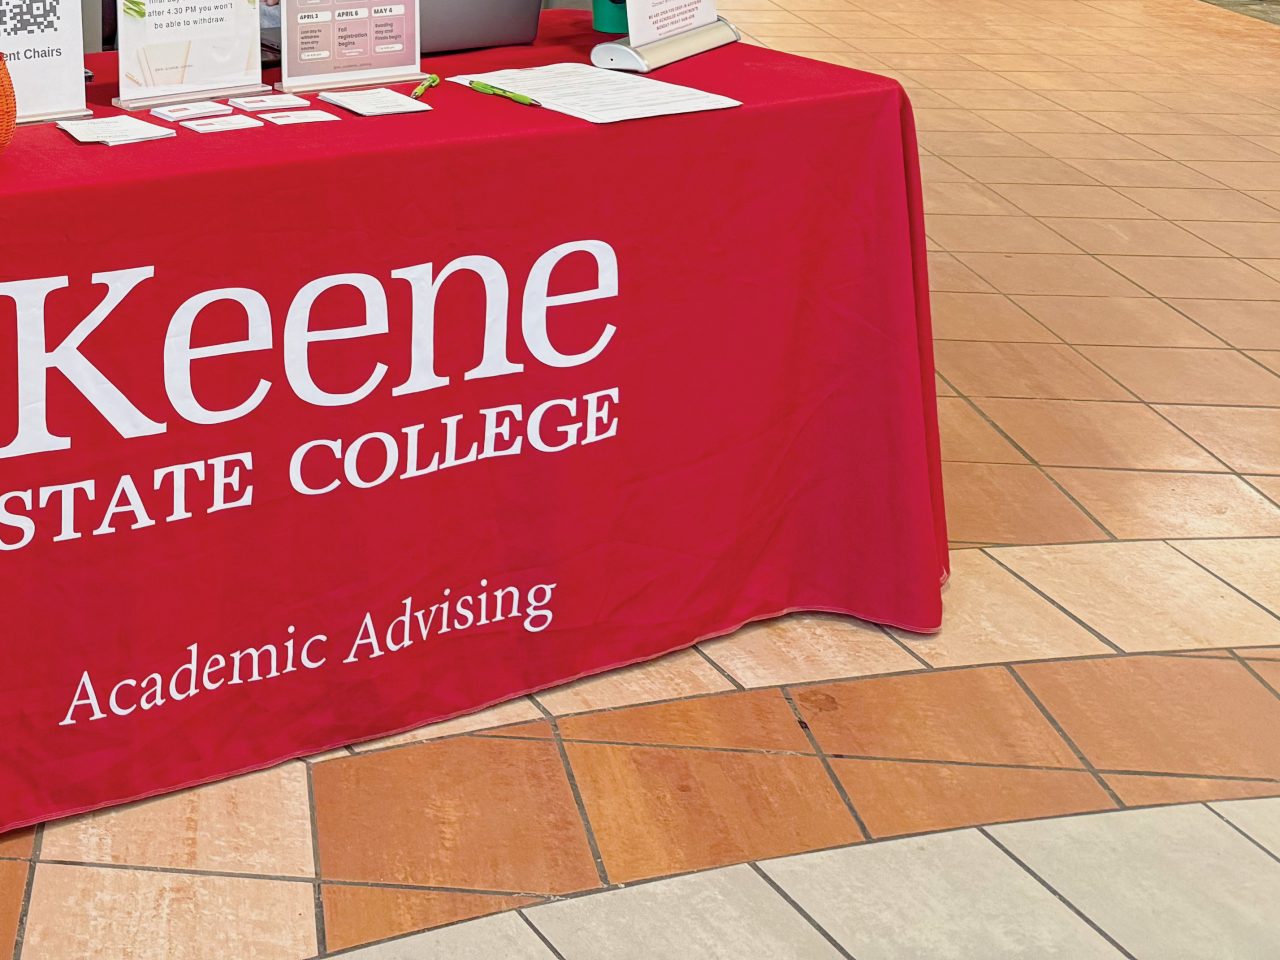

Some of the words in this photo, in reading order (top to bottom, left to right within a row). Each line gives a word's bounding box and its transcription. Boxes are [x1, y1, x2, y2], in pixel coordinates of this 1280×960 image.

[147, 9, 165, 17] after
[185, 5, 197, 13] PM
[198, 5, 212, 13] you
[165, 20, 181, 28] able
[23, 47, 62, 60] Chairs
[289, 387, 619, 495] COLLEGE
[59, 625, 327, 725] Academic
[343, 578, 557, 663] Advising
